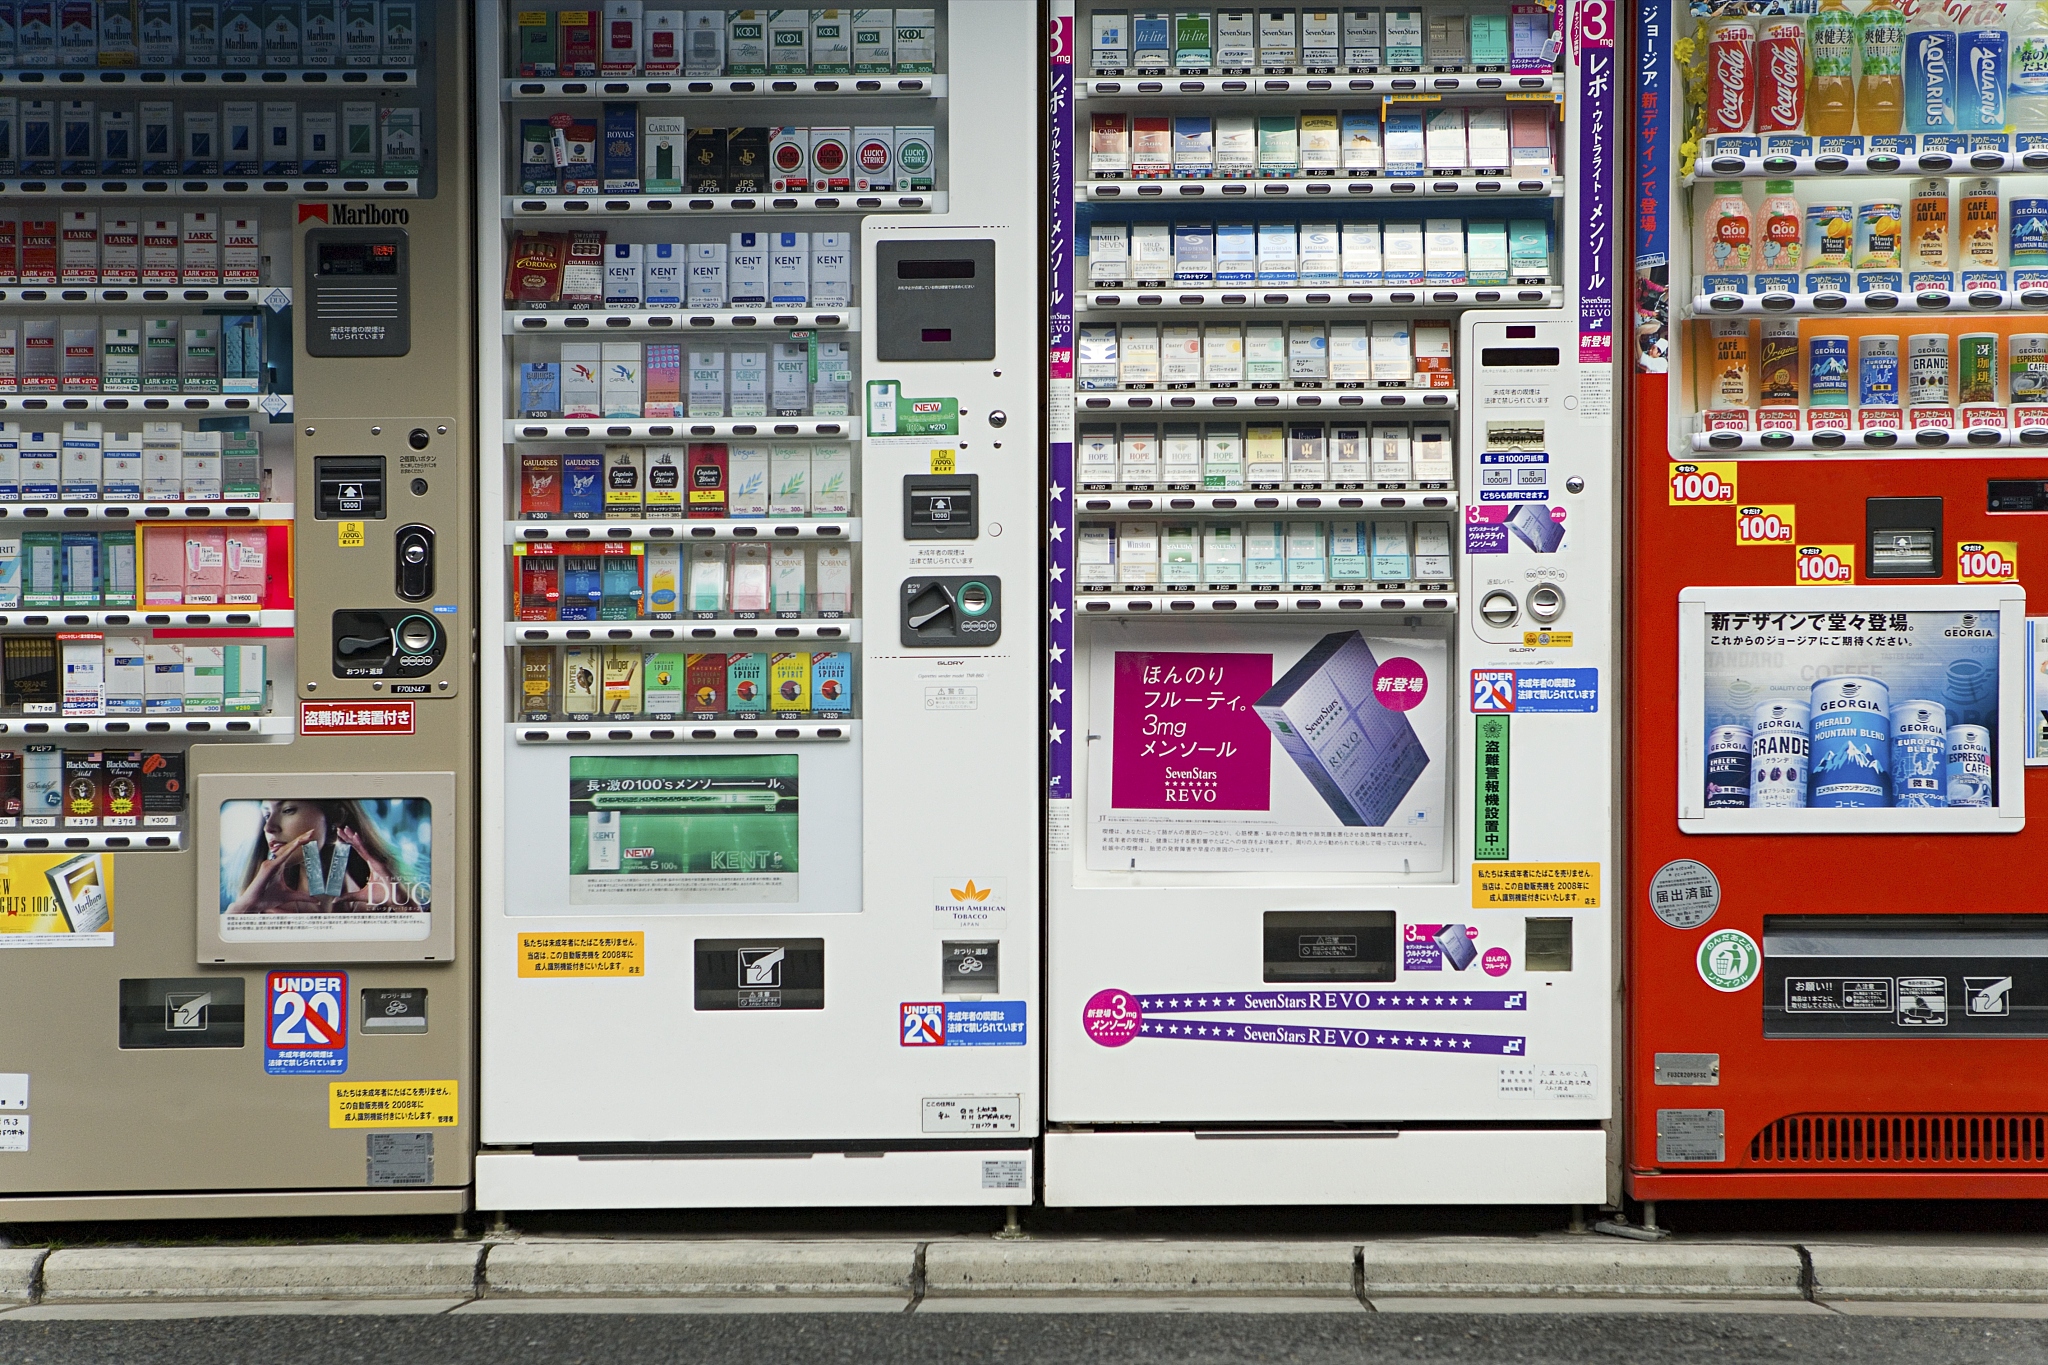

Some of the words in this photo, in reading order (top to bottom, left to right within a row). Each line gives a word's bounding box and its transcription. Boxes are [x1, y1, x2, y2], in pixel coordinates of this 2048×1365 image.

[307, 27, 335, 41] Marlboro
[736, 27, 759, 37] KOOL
[819, 28, 837, 36] KOOL
[898, 30, 924, 39] KOOL
[1179, 30, 1208, 42] hi-lite
[1815, 30, 1853, 44] 爽健美茶
[60, 35, 93, 47] Marlboro
[225, 35, 258, 49] Marlboro
[1771, 43, 1797, 126] Coca-Cola
[1927, 35, 1944, 125] AQUARIUS
[1982, 47, 1996, 124] AQUARIUS
[1717, 45, 1744, 128] Coca-Cola
[649, 124, 680, 132] CARLTON
[386, 143, 415, 154] Marlboro
[863, 156, 884, 164] STRIKE
[1917, 201, 1937, 211] CAFÉ
[333, 204, 409, 224] Marlboro
[1917, 212, 1928, 221] AU
[1930, 212, 1946, 221] LAIT
[68, 231, 92, 239] LARK
[1722, 225, 1745, 236] Qoo
[517, 258, 557, 269] CORONAS
[1581, 335, 1610, 348] 新登場
[111, 345, 134, 353] LARK
[1914, 358, 1948, 370] GRANDE
[733, 446, 756, 460] Vogue
[1673, 474, 1732, 499] 100円
[1739, 517, 1790, 539] 100円
[1127, 541, 1150, 549] Winston
[1960, 553, 2011, 577] 100円
[1711, 613, 1914, 631] 新デザインで堂々登場。
[1711, 635, 1913, 647] これからのジョージアにご期待ください。
[526, 664, 546, 672] axx
[607, 658, 629, 671] villiger
[569, 665, 577, 693] PANTER
[734, 670, 760, 678] SPIRIT
[1143, 665, 1224, 685] ほんのり
[398, 685, 425, 693] F70LN47
[1377, 677, 1423, 692] 新登場
[1518, 678, 1576, 688] 未成年者の喫煙は
[1474, 682, 1512, 709] 20
[1518, 690, 1596, 699] 法律で禁じられています
[1144, 690, 1246, 712] フルーティ。
[1821, 700, 1881, 711] GEORGIA
[305, 710, 409, 725] 盗難防止装置付き
[1815, 717, 1851, 729] EMERALD
[1143, 715, 1186, 737] 3mg
[1815, 729, 1858, 740] MOUNTAIN
[1860, 729, 1885, 740] BLEND
[1140, 740, 1236, 758] メンソール
[1898, 739, 1945, 747] EUROPEAN
[1912, 780, 1934, 788] 微糖
[1166, 789, 1216, 802] REVO
[1485, 741, 1499, 846] 盗難警報機設置中
[1817, 786, 1883, 795] エメラルドマウンテンブレンド
[626, 849, 652, 857] NEW
[711, 851, 770, 869] KENT
[1478, 870, 1593, 878] 私たちは未成年者にたばこを売りません。
[366, 883, 431, 905] DUO
[1657, 886, 1713, 903] 届出済証
[33, 897, 57, 912] 100's
[524, 939, 637, 947] 私たちは未成年者にたばこを売りません。
[1707, 935, 1751, 953] のんだあとは
[535, 962, 624, 971] 成人識別機能付きにいたします。
[274, 978, 340, 992] UNDER
[1708, 972, 1748, 987] リサイクル
[1795, 982, 1832, 991] お願い!!
[1309, 992, 1370, 1009] REVO
[272, 992, 340, 1044] 20
[947, 1012, 1004, 1021] 未成年者の喫煙は
[904, 1015, 942, 1043] 20
[947, 1023, 1024, 1032] 法律で禁じられています
[1091, 1020, 1135, 1031] メンソール
[336, 1089, 451, 1098] 私たちは未成年者にたばこを売りません。
[345, 1112, 434, 1121] 成人識別機能付きにいたします。
